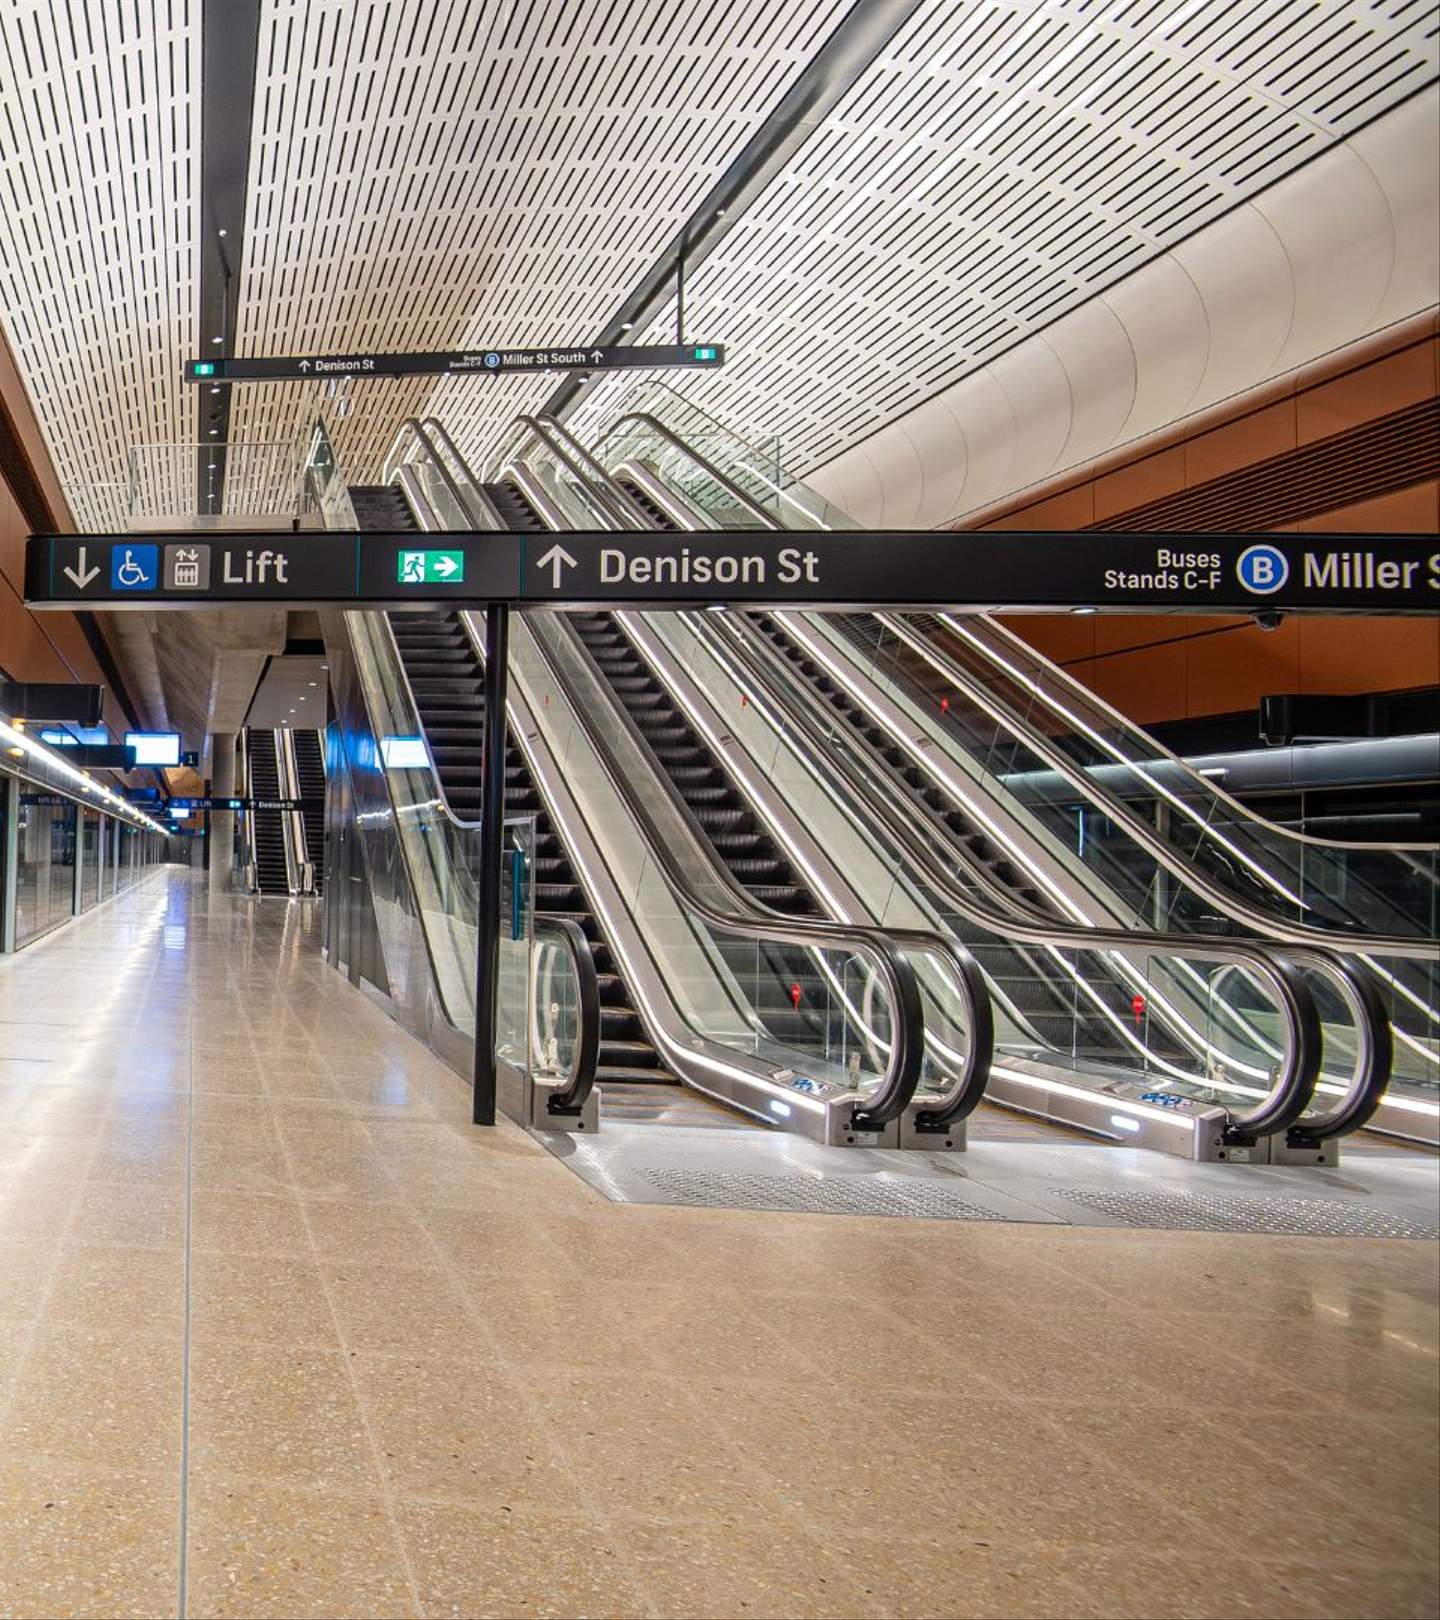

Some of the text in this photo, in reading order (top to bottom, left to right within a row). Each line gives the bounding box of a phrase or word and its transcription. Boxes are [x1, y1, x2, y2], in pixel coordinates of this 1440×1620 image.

[315, 359, 374, 371] Denison St
[502, 352, 586, 365] Miller St South
[223, 550, 289, 583] Lift
[600, 548, 819, 583] Denison St
[1157, 549, 1221, 568] Buses
[1104, 570, 1221, 590] Stands C-F
[1251, 556, 1274, 584] B
[1304, 553, 1419, 588] Miller
[187, 755, 192, 763] 1
